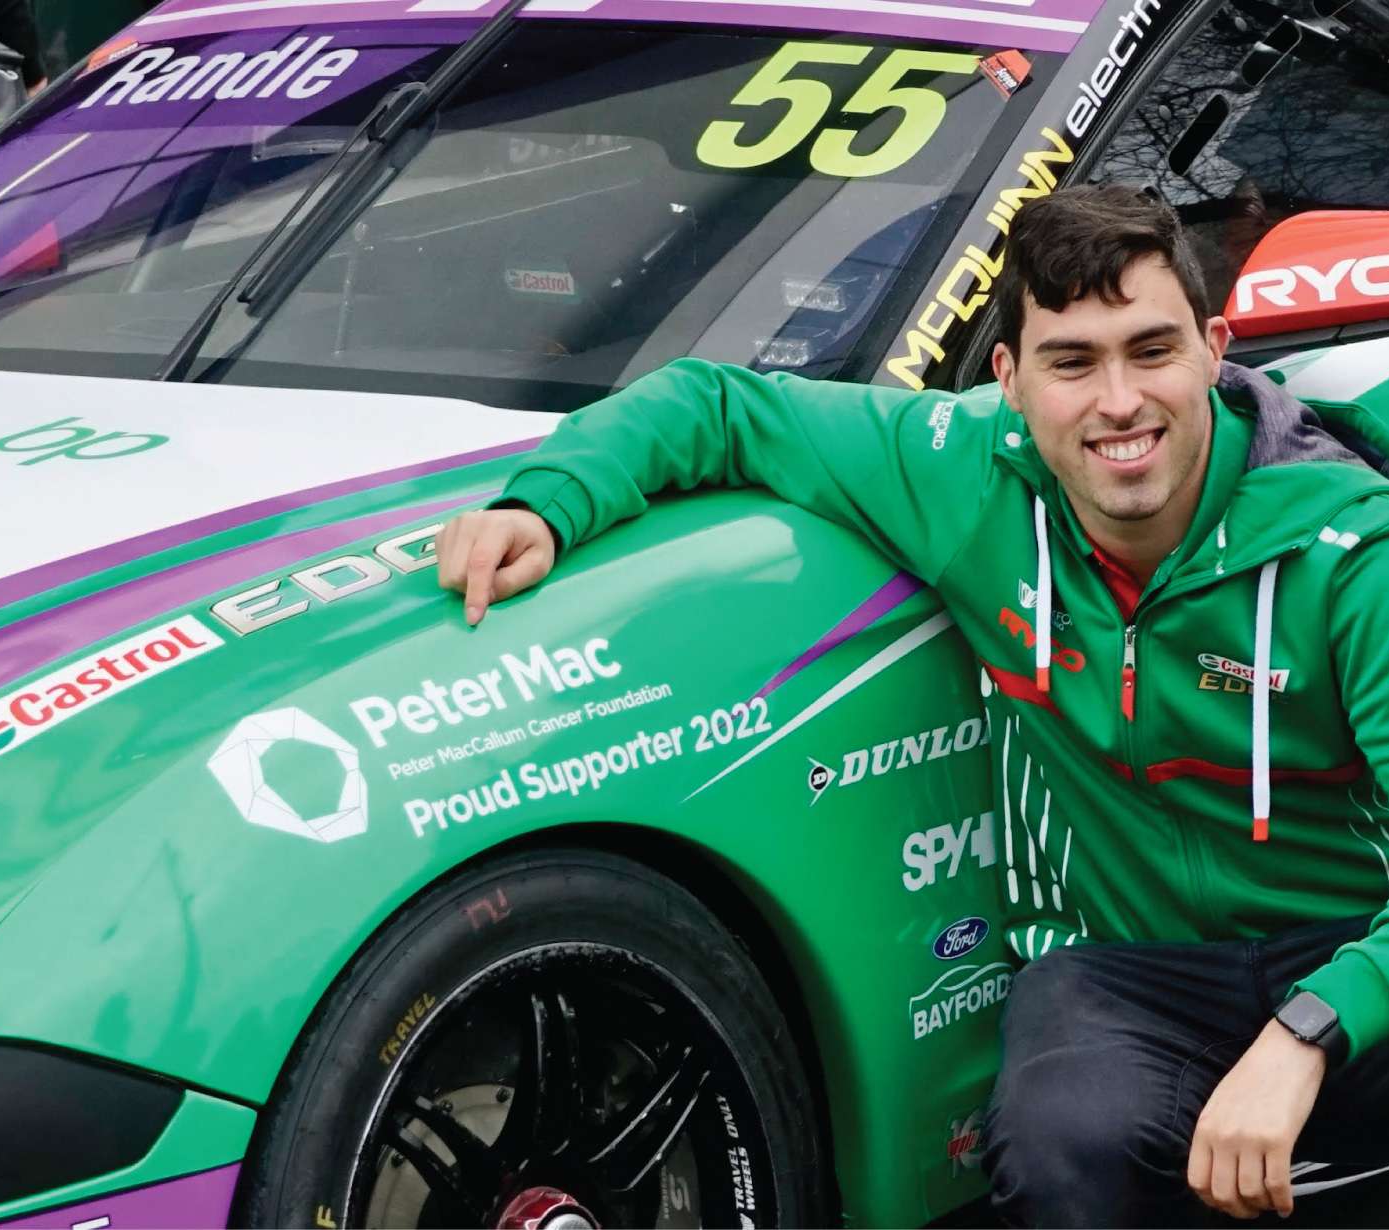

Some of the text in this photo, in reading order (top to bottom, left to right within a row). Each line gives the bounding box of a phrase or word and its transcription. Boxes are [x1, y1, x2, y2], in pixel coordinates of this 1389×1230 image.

[77, 35, 360, 110] Randle
[695, 41, 984, 178] 55
[522, 272, 572, 292] Castrol
[7, 522, 447, 728] Castrol EDG
[348, 637, 622, 749] Peter Mac
[387, 680, 673, 782] Peter MacCallum Cancer Foundation
[402, 695, 773, 839] Proud Supporter 2022
[837, 716, 991, 788] DUNLO
[913, 972, 1011, 1041] BAYFORD
[727, 1146, 746, 1210] TRAVEL
[737, 1146, 756, 1211] WHEELS
